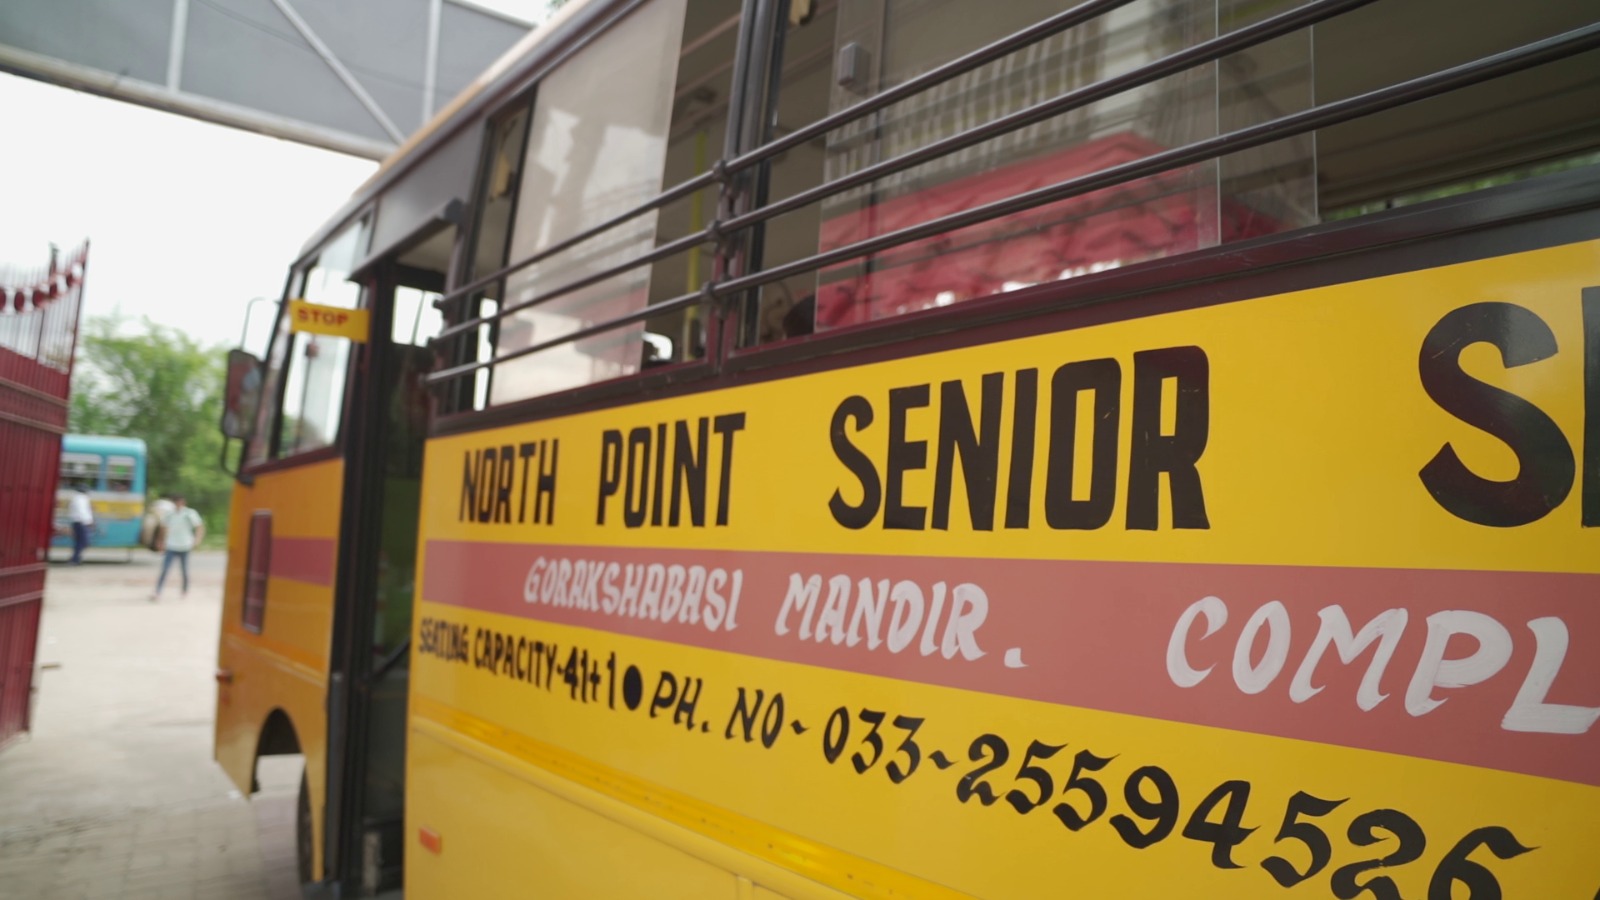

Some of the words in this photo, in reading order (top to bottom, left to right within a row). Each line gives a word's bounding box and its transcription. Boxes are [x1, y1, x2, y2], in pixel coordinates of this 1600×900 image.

[298, 308, 349, 327] STOP
[459, 439, 559, 526] NORTH
[596, 412, 746, 529] POINT
[828, 346, 1210, 532] SENIOR
[418, 617, 469, 666] SEATING
[649, 671, 711, 733] PH.
[523, 556, 743, 632] GORAKSHABASI
[1166, 595, 1600, 735] COMPL
